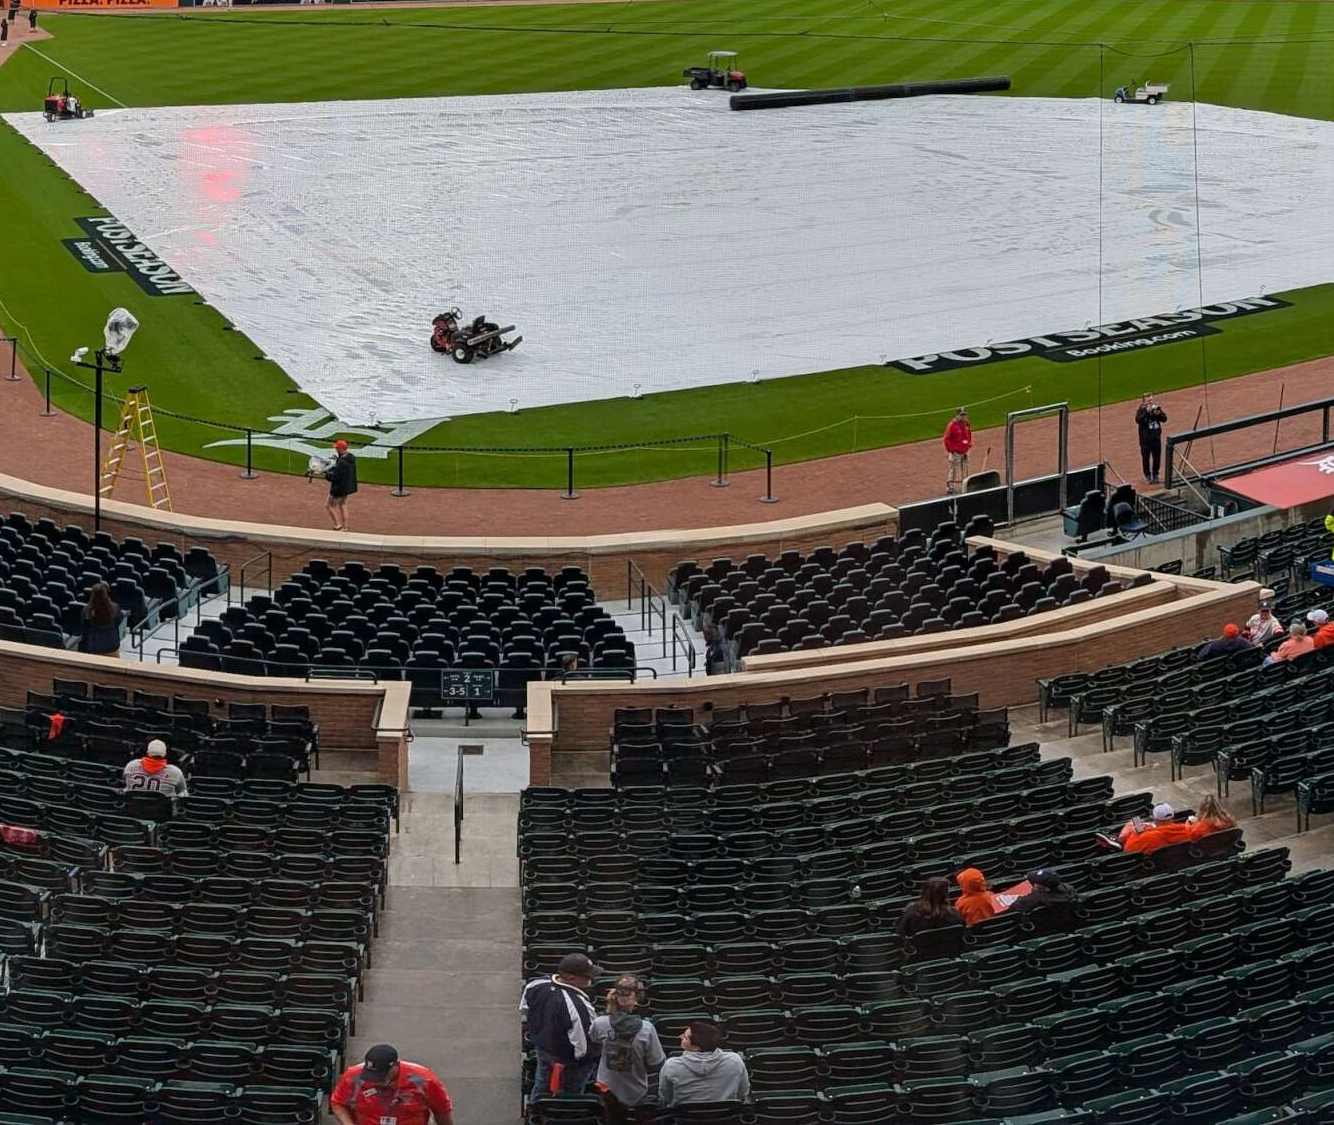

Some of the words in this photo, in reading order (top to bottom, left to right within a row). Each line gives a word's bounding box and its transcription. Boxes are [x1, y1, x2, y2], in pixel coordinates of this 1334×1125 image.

[1066, 328, 1197, 359] Booking.com
[464, 674, 471, 683] 2
[449, 687, 466, 696] 3-5
[475, 687, 480, 696] 1
[133, 775, 161, 791] 20
